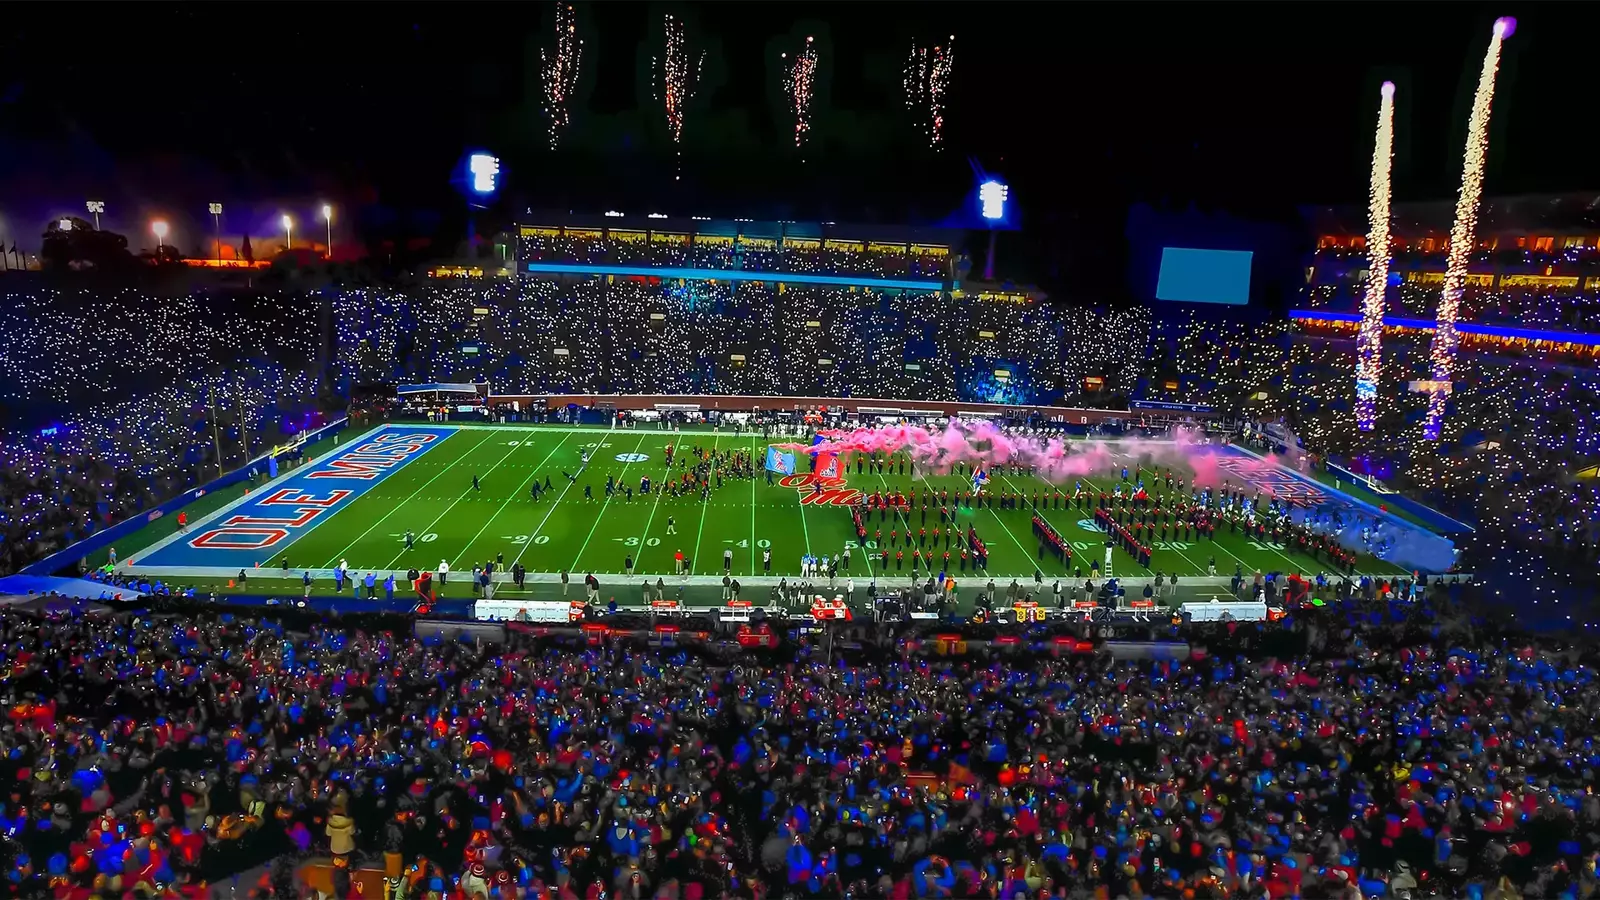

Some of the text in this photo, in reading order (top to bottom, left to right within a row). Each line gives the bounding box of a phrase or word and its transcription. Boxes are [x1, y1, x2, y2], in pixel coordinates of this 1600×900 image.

[615, 453, 649, 462] SEC
[779, 473, 848, 488] Oe
[188, 433, 439, 549] OLE MISS
[511, 535, 549, 544] 20
[624, 537, 661, 546] 30
[735, 539, 771, 548] 40
[845, 540, 877, 549] 50
[1153, 542, 1189, 550] 20
